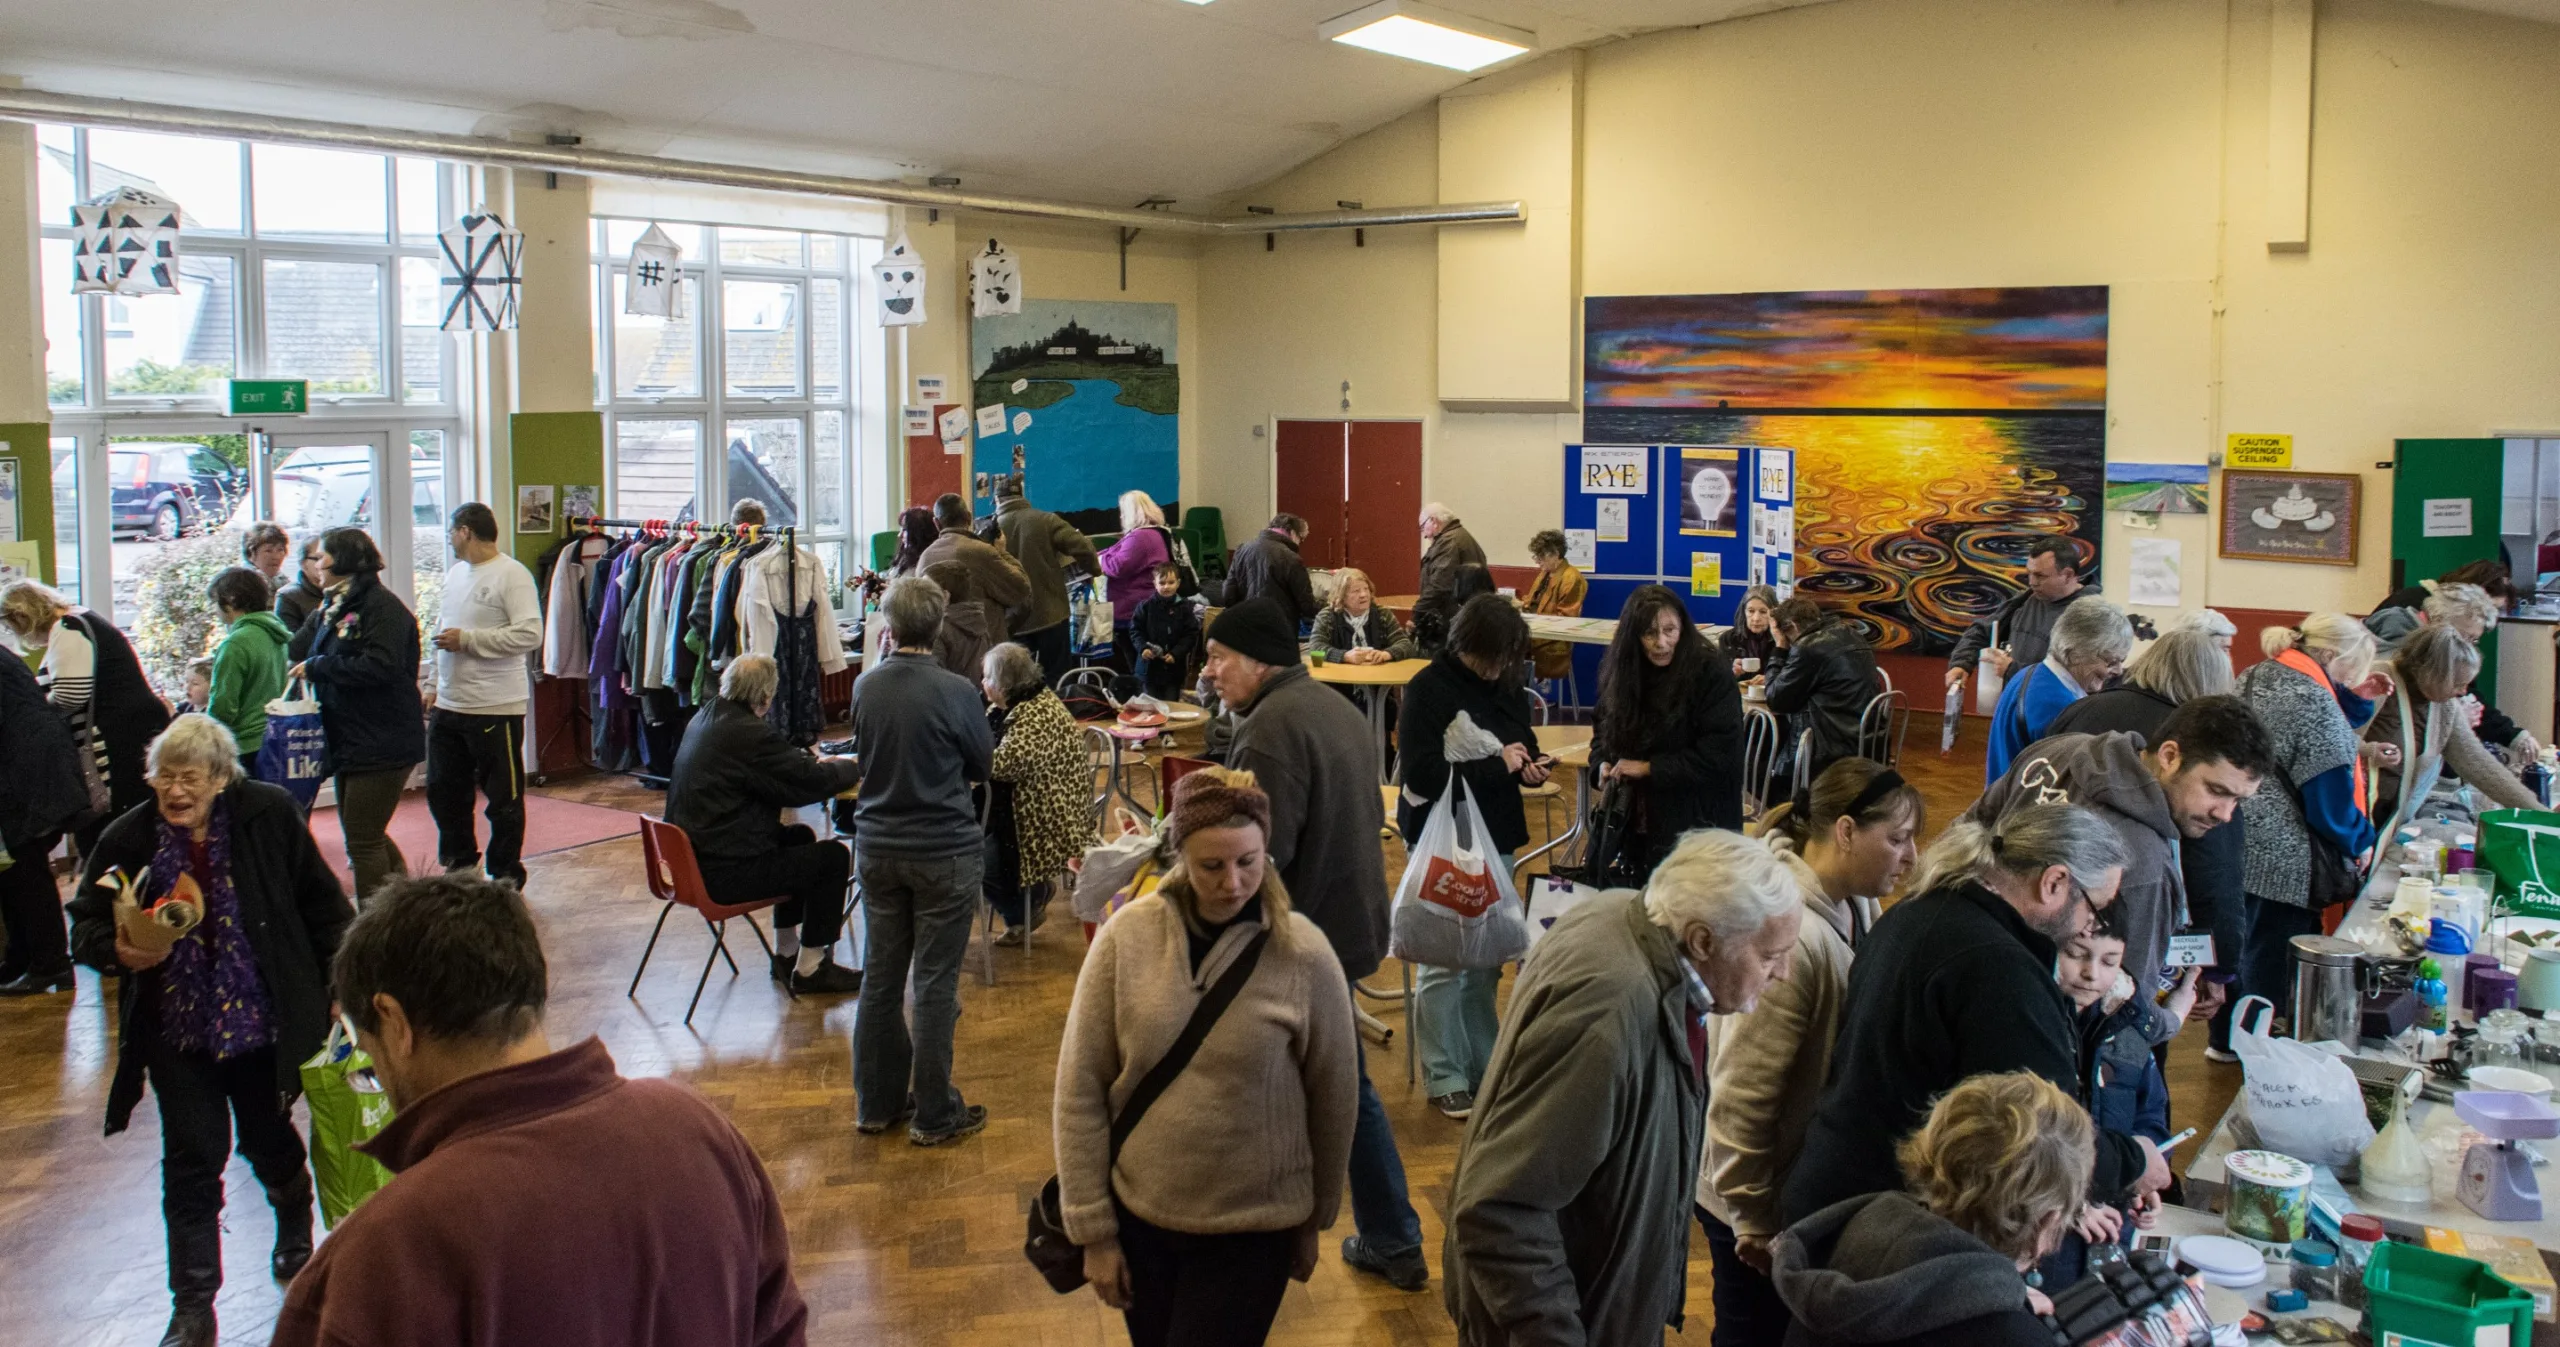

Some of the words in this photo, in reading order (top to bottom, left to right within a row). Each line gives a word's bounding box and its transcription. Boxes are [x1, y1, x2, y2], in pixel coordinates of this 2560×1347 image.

[242, 393, 265, 402] EXIT
[2238, 438, 2280, 446] CAUTION
[2233, 447, 2285, 455] SUSPENDED
[2238, 455, 2277, 463] CEILING
[1586, 463, 1636, 487] RYE
[1761, 467, 1784, 493] RYE
